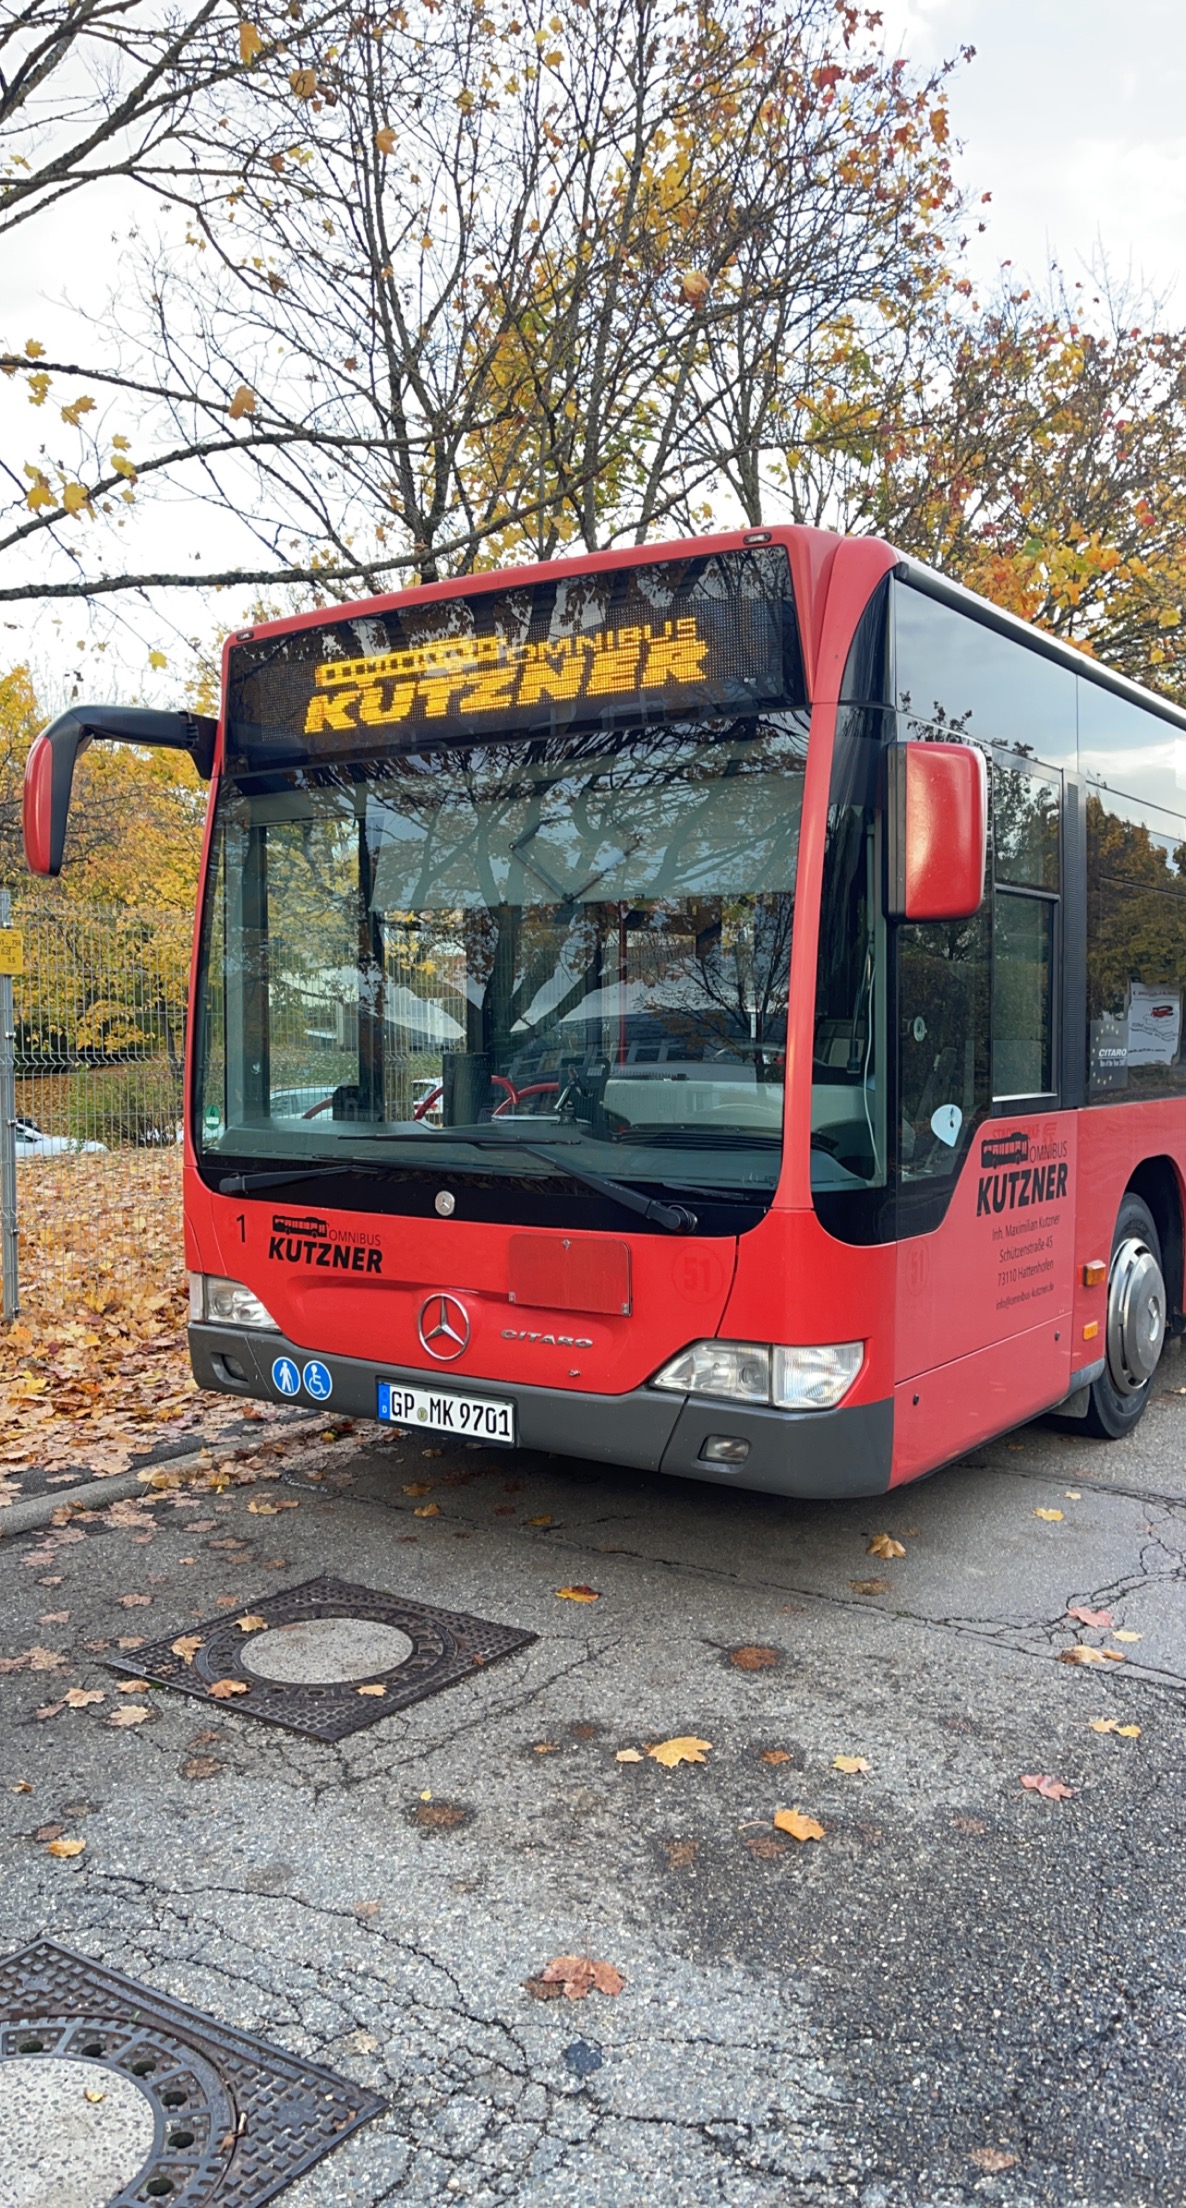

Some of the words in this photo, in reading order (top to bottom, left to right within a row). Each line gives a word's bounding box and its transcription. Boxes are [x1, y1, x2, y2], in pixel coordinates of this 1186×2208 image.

[506, 617, 697, 665] OMNIBUS
[304, 641, 708, 734] KUTZNER
[1098, 1048, 1127, 1058] CITARO
[1029, 1140, 1068, 1163] OMNIBUS
[976, 1162, 1068, 1217] KUTZNER
[236, 1214, 246, 1243] 1
[328, 1229, 382, 1247] OMNIBUS
[1005, 1218, 1038, 1238] Maximilian
[1038, 1214, 1061, 1229] Kutzner
[268, 1236, 383, 1274] KUTZNER
[999, 1237, 1045, 1263] Schützenstraße
[1045, 1234, 1054, 1249] 45
[683, 1257, 710, 1292] 51
[997, 1267, 1017, 1287] 73110
[1017, 1257, 1054, 1281] Hattenhofen
[501, 1328, 593, 1349] CITARO
[382, 1405, 388, 1413] D
[391, 1391, 414, 1418] GP
[430, 1397, 454, 1427] MK
[459, 1402, 510, 1437] 9701
